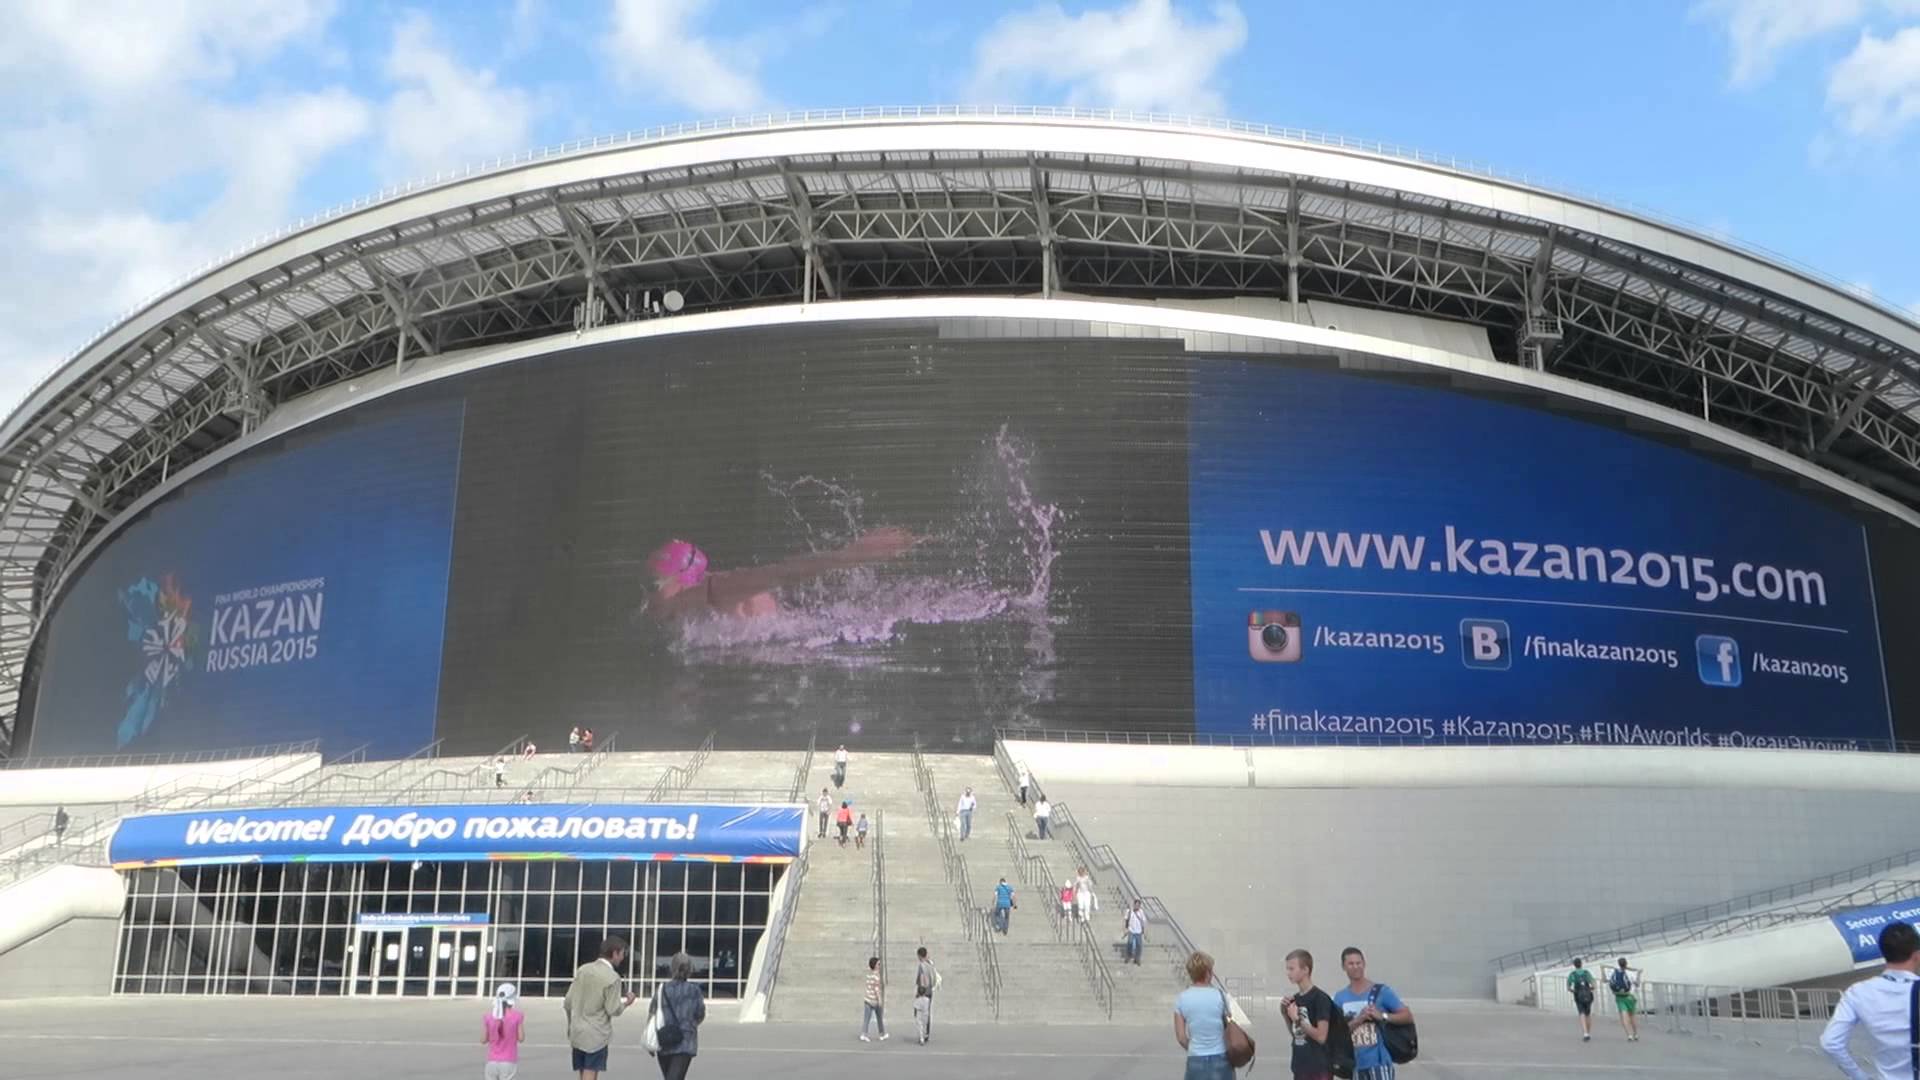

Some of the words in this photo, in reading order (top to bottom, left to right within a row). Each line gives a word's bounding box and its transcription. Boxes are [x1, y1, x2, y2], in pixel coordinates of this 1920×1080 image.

[1259, 525, 1828, 606] www.kazan2015.com
[210, 592, 323, 646] KAZAN
[207, 643, 268, 672] RUSSIA
[270, 635, 318, 664] 2015
[1313, 626, 1445, 654] /kazan2015
[1523, 635, 1679, 668] /finakazan2015
[1752, 652, 1849, 683] /kazan2015
[1251, 709, 1435, 739] #finakazan2015
[1442, 715, 1574, 744] #Kazan2015
[1580, 722, 1711, 748] #FINAworlds
[185, 815, 335, 846] Welcome!
[341, 811, 457, 848] Добро
[463, 812, 699, 841] пожаловать!
[1845, 916, 1886, 929] Sectors
